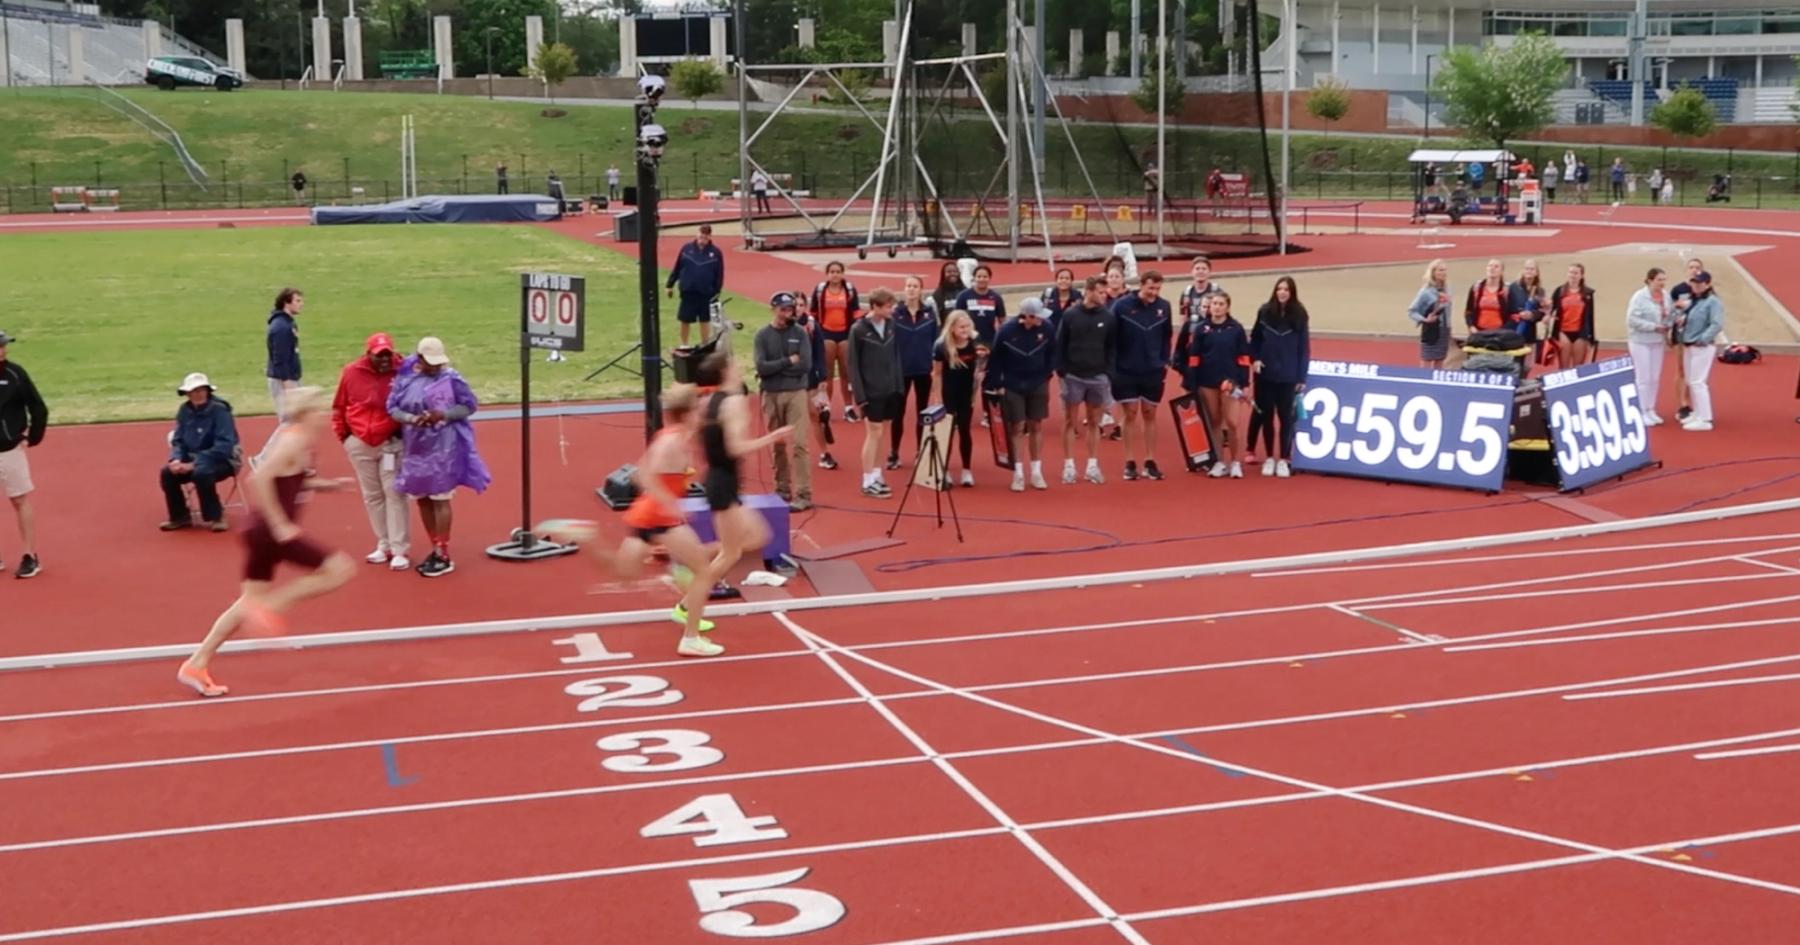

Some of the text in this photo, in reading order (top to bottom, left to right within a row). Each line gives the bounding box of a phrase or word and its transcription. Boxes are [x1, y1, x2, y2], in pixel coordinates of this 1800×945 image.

[1307, 360, 1379, 377] MEN'S MILE
[1432, 370, 1476, 382] SECTION
[1488, 373, 1503, 385] OF
[1295, 387, 1505, 476] 3:59.5
[1550, 383, 1647, 475] 3:59.5
[553, 632, 634, 665] 1
[564, 675, 685, 713] 2
[596, 728, 725, 774] 3
[639, 793, 790, 848] 4
[688, 866, 848, 939] 5
